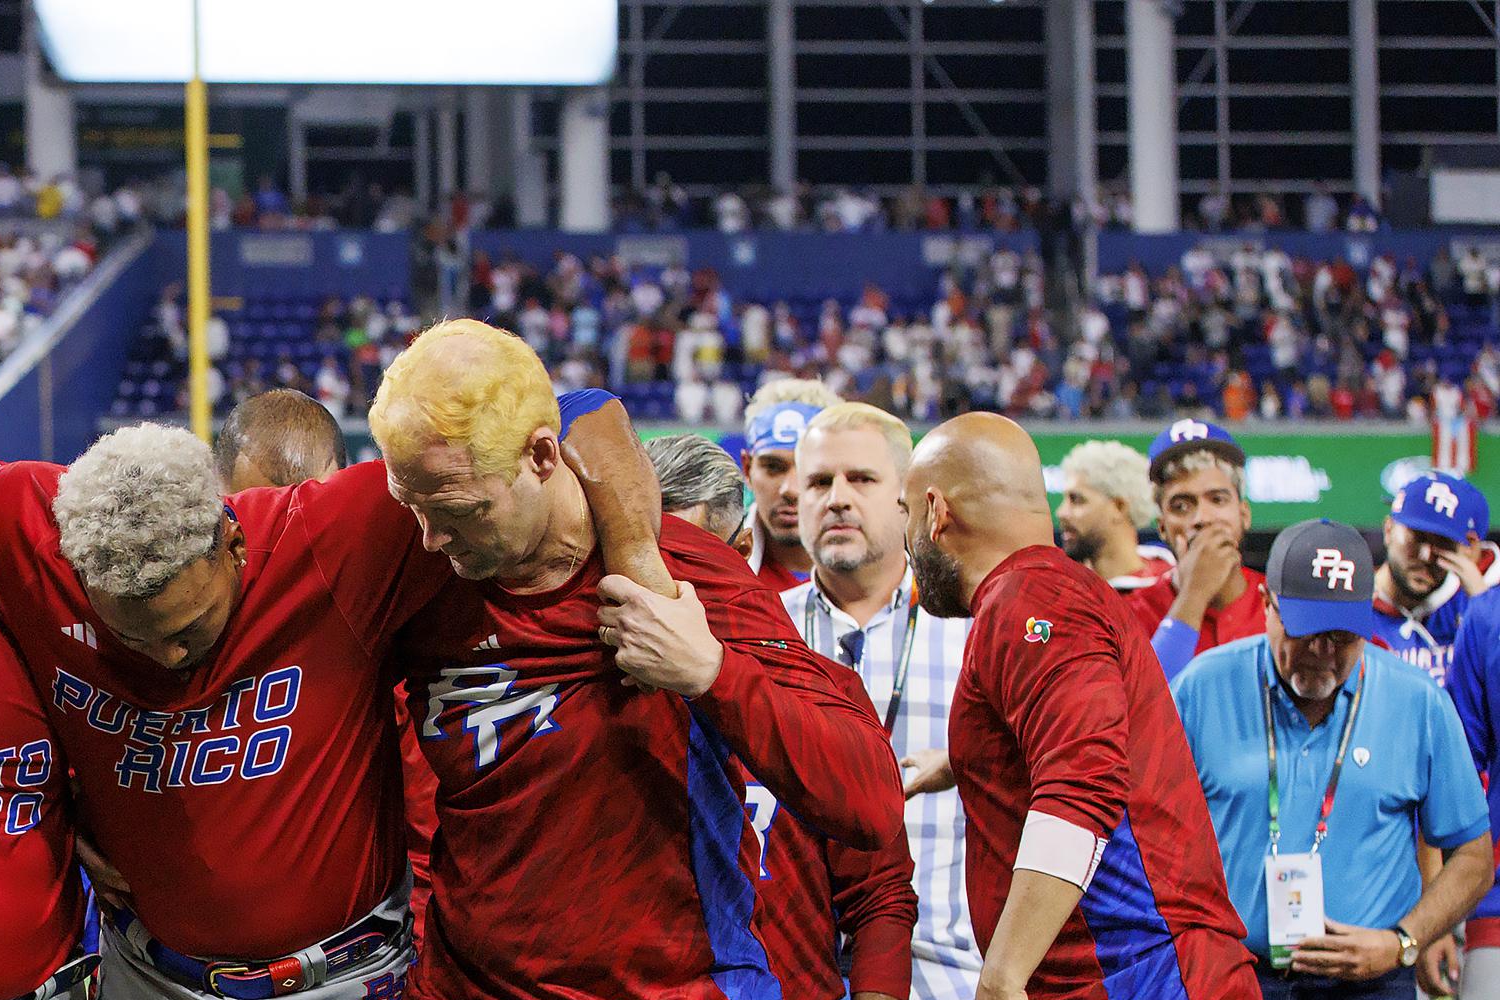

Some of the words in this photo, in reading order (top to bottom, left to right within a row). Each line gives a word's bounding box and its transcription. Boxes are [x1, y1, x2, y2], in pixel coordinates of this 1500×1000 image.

[1311, 548, 1356, 592] PR
[51, 665, 302, 746] PUERTO
[114, 725, 292, 794] RICO
